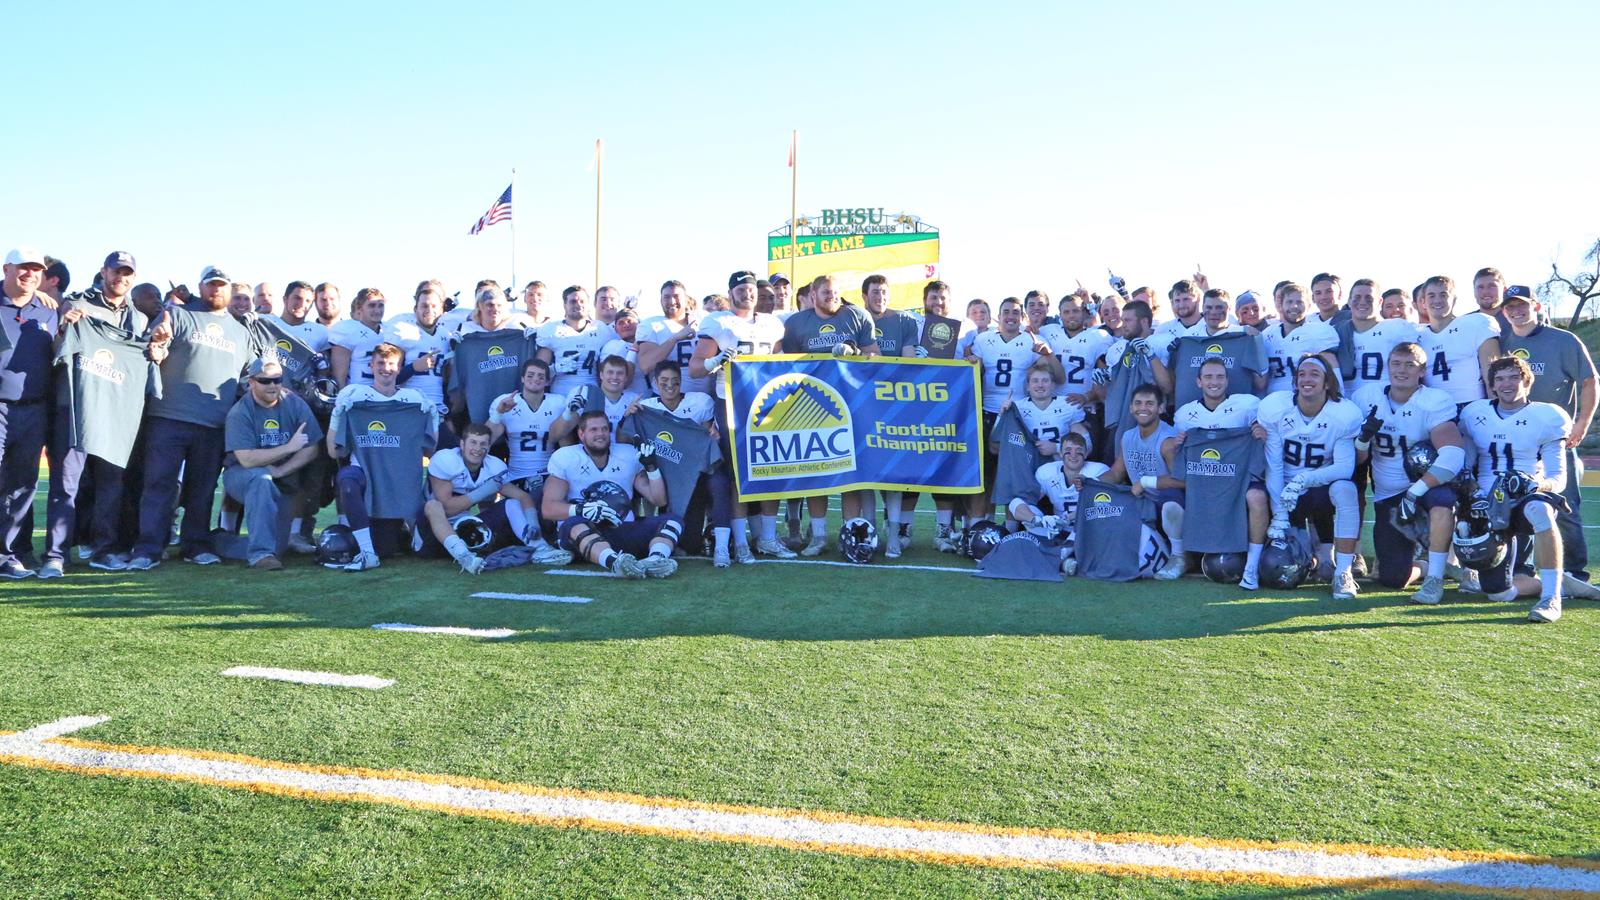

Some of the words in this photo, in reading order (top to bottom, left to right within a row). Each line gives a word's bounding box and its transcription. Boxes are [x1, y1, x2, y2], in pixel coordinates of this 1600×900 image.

[821, 207, 884, 226] BHSU
[809, 225, 850, 235] YELLOW
[854, 224, 897, 234] JACKETS
[771, 241, 816, 260] NEXT
[820, 235, 865, 253] GAME
[995, 358, 1012, 387] 8
[874, 381, 949, 402] 2016
[875, 421, 956, 437] Football
[750, 428, 850, 464] RMAC
[865, 434, 968, 454] Champions
[1283, 438, 1325, 469] 96
[1488, 441, 1514, 471] 11
[752, 466, 770, 476] Rocky
[771, 464, 798, 474] Mountain
[799, 462, 820, 471] Athletic
[1186, 461, 1236, 477] CHAMPION
